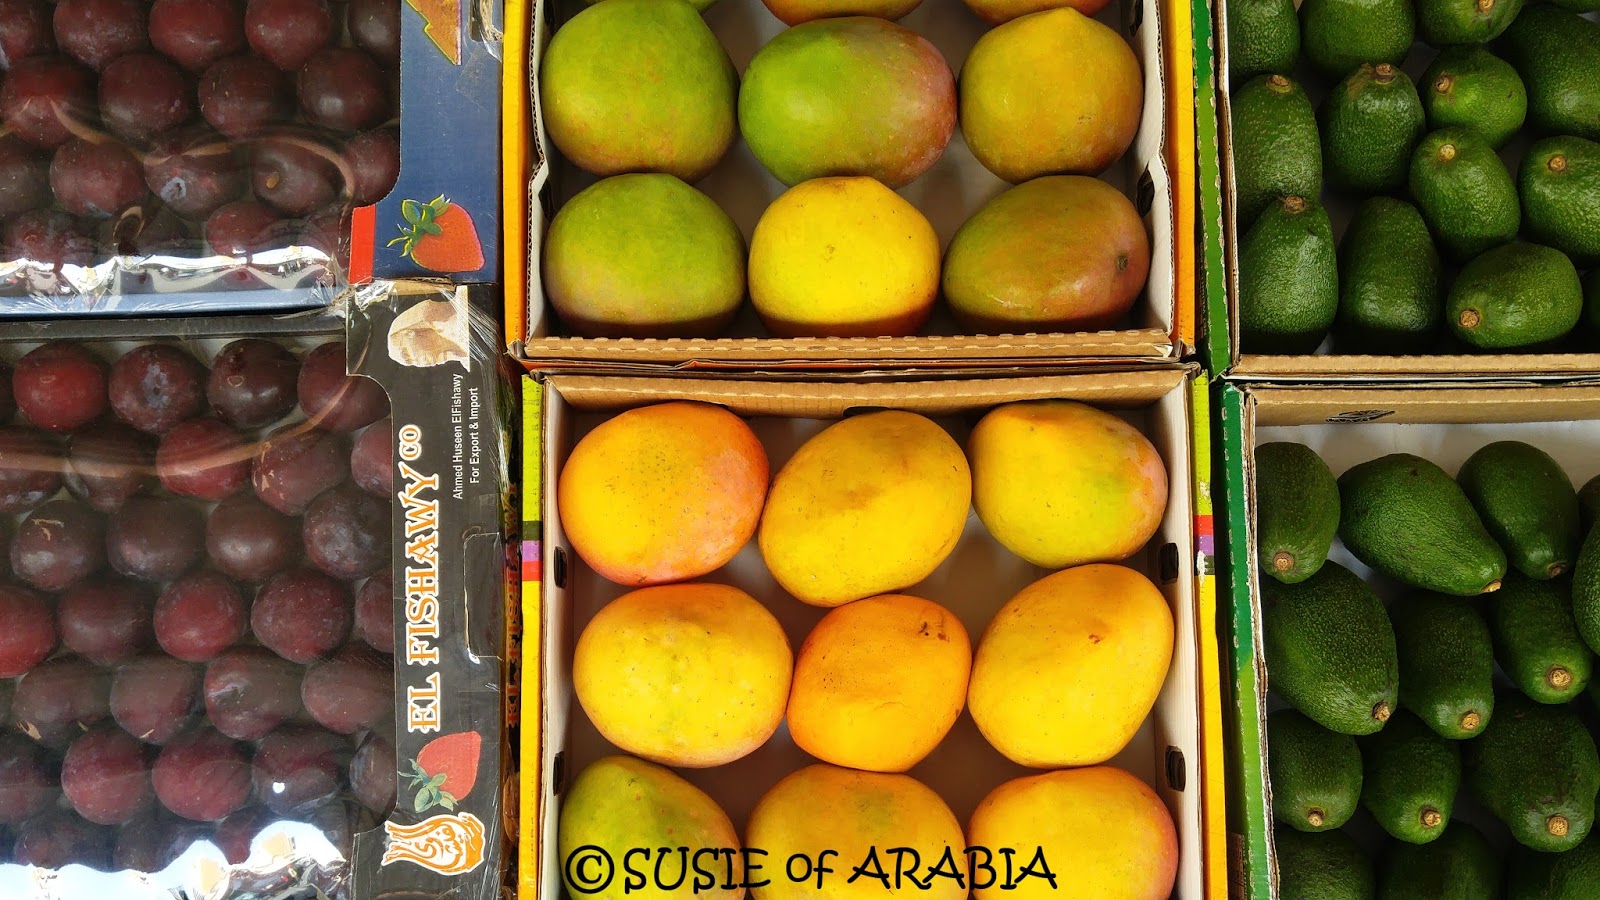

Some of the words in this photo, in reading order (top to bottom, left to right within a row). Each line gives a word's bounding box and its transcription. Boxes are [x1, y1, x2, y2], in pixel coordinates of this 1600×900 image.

[451, 373, 464, 424] ElFishawy
[468, 387, 481, 420] Import
[468, 421, 479, 430] &
[452, 425, 463, 463] Huseen
[469, 431, 482, 465] Export
[452, 464, 463, 500] Ahmed
[469, 466, 480, 484] For
[398, 460, 440, 666] FISHAWY
[407, 671, 441, 734] EL
